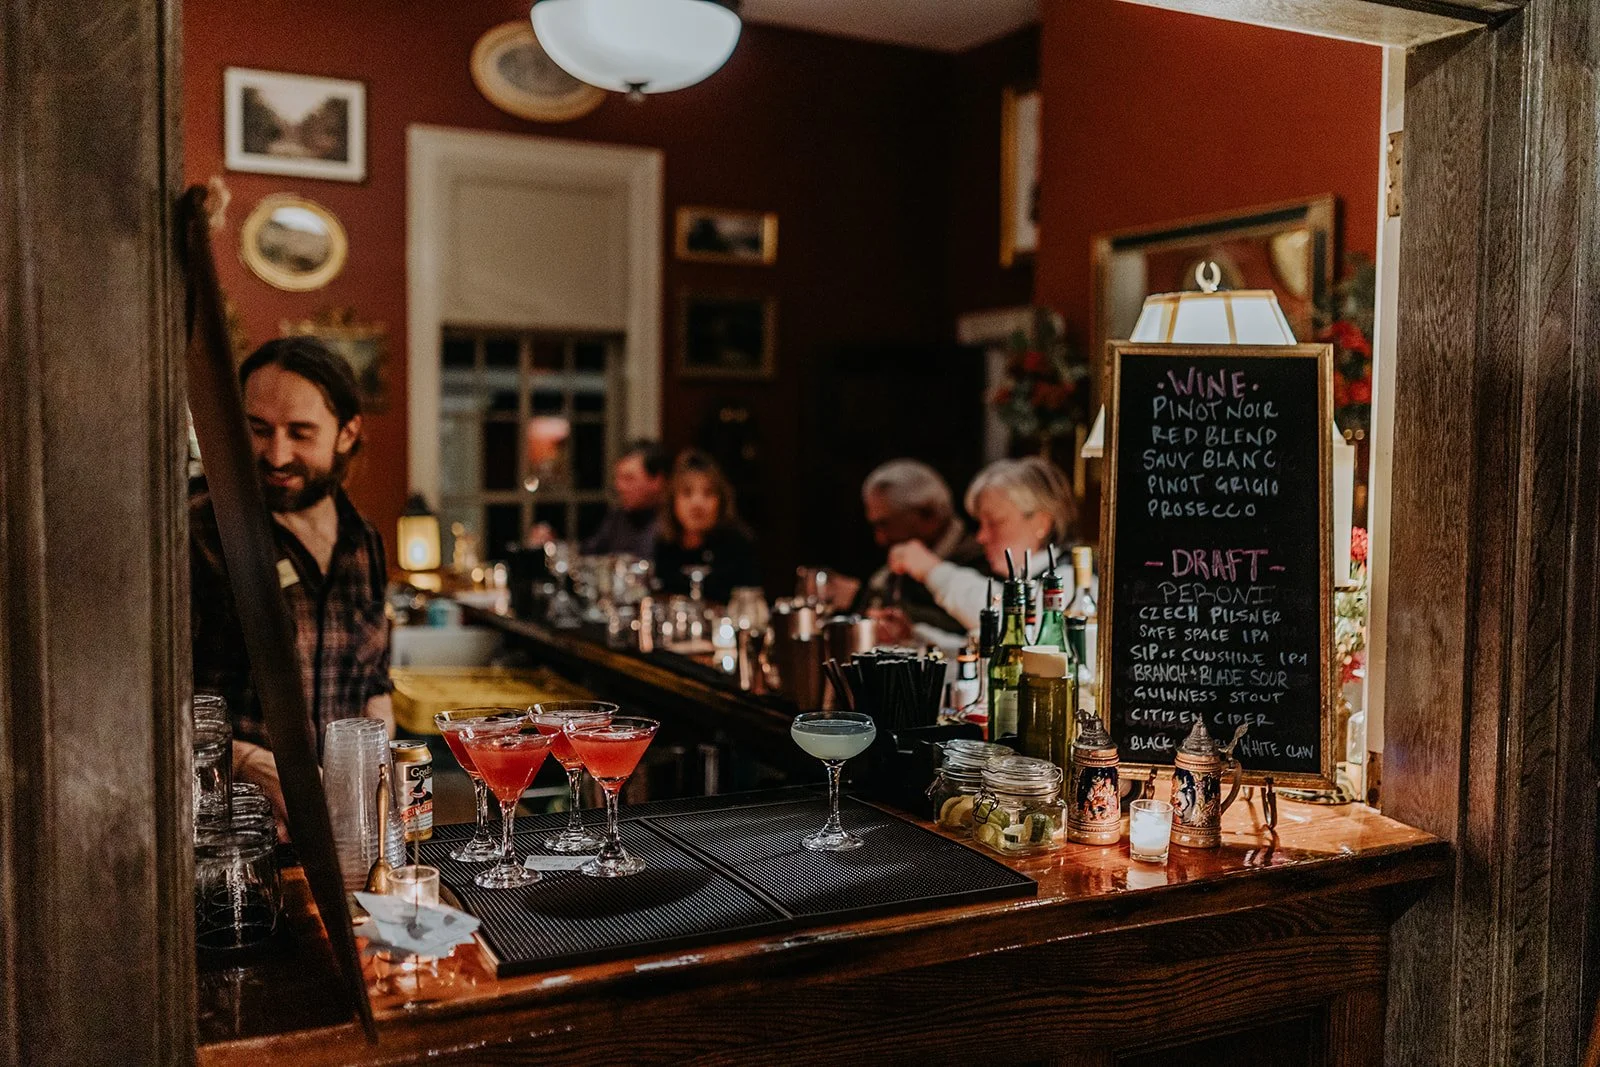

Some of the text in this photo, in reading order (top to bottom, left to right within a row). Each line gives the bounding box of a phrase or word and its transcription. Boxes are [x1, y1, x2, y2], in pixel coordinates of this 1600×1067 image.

[1167, 367, 1246, 399] WINE
[1152, 396, 1279, 421] PINOT NOIR
[1152, 426, 1277, 445] RED BLEND
[1143, 449, 1276, 470] SAUV BLANC
[1148, 473, 1279, 496] PINOT GRIGIO
[1148, 499, 1256, 519] PROSECCO
[1172, 549, 1269, 582] DRAFT
[1139, 605, 1281, 625] CZECH PILSNER
[1139, 624, 1269, 644] SAFE SPACE IPA
[1130, 643, 1159, 661] SIP
[1181, 648, 1266, 666] SUNSHINE
[1280, 652, 1307, 666] IPA
[1133, 663, 1187, 683] BRANCH
[1200, 665, 1245, 686] BLADE
[1250, 670, 1289, 689] SOUR
[1133, 686, 1284, 703] GUINNESS STOUT
[1131, 709, 1274, 726] CITIZEN CIDER
[1130, 736, 1173, 750] BLACK
[1240, 735, 1280, 757] WHITE
[1286, 745, 1314, 759] CLAW
